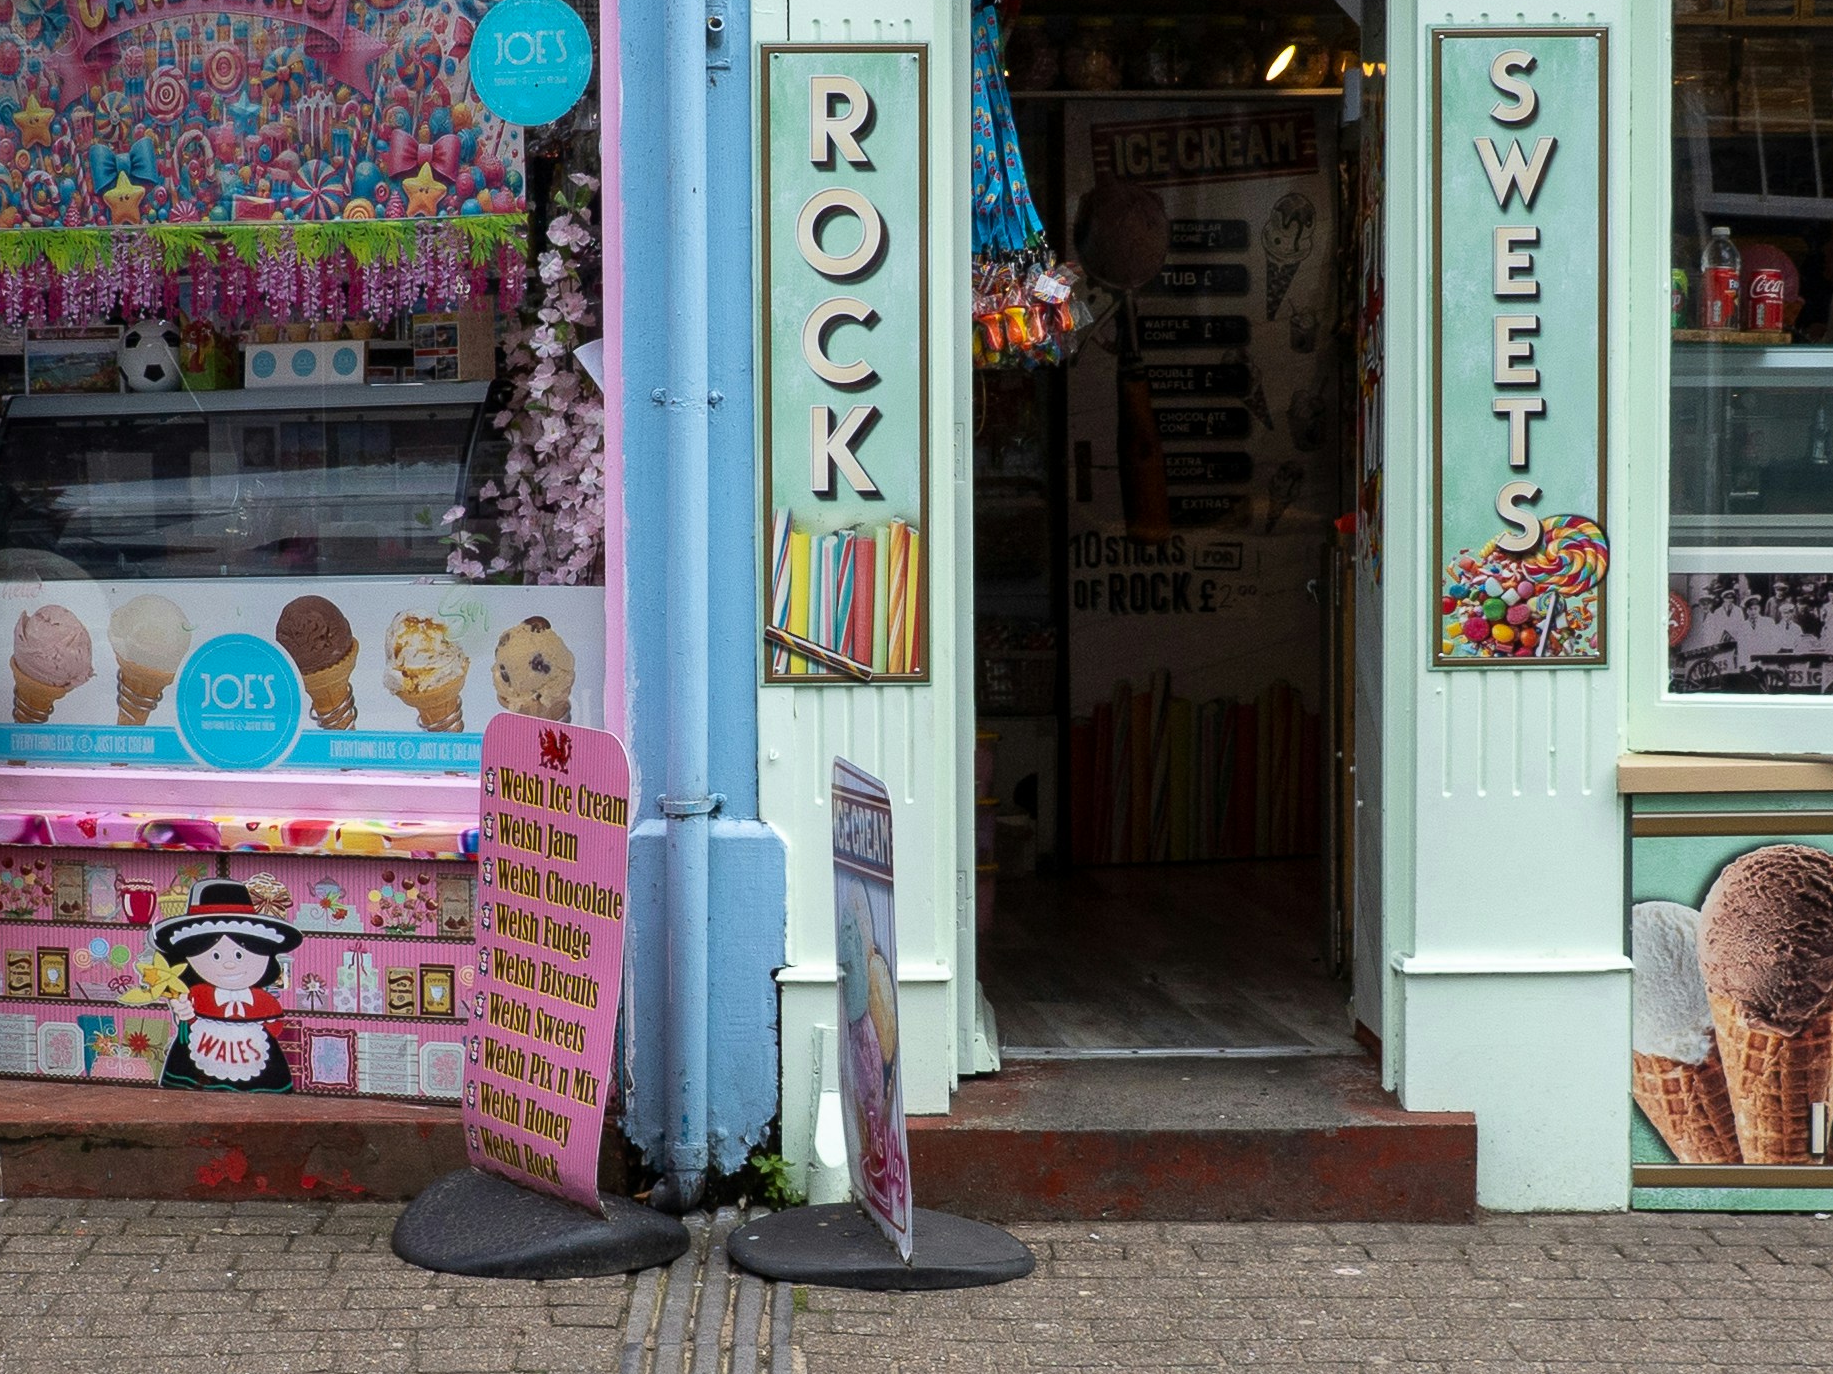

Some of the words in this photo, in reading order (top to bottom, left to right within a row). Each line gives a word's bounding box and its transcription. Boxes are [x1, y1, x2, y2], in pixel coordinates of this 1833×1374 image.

[1114, 132, 1169, 175] ICE
[1177, 121, 1297, 172] CREAM
[794, 74, 882, 498] ROCK
[1161, 273, 1196, 286] TUB
[1474, 48, 1558, 555] SWEETS
[1181, 499, 1230, 510] EXTRAS
[1069, 530, 1101, 569] 10
[1105, 534, 1185, 566] STICKS
[1074, 579, 1103, 610] OF
[1109, 572, 1191, 614] ROCK
[201, 673, 277, 710] JOE'S
[11, 732, 56, 751] EVERYTHING
[58, 734, 75, 752] ELSE
[94, 735, 114, 753] JUST
[115, 735, 126, 753] ICE
[127, 736, 155, 754] CREAM
[329, 739, 377, 757] EVERYTHING
[378, 740, 396, 758] ELSE
[417, 742, 437, 759] JUST
[438, 743, 450, 759] ICE
[499, 767, 543, 808] Welsh
[547, 777, 572, 814] Ice
[577, 785, 628, 827] Cream
[497, 812, 543, 854] Welsh
[546, 825, 579, 863] Jam
[851, 805, 892, 867] CREAM
[496, 858, 541, 900] Welsh
[544, 871, 623, 922] Chocolate
[494, 902, 540, 946] Welsh
[542, 915, 592, 961] Fudge
[493, 947, 537, 990] Welsh
[539, 962, 599, 1011] Biscuits
[195, 1033, 262, 1065] WALES
[488, 992, 530, 1035] Welsh
[534, 1007, 587, 1054] Sweets
[484, 1037, 525, 1080] Welsh
[529, 1053, 555, 1093] Pix
[558, 1066, 567, 1092] n
[571, 1067, 600, 1107] Mix
[480, 1082, 521, 1126] Welsh
[524, 1100, 571, 1148] Honey
[480, 1126, 521, 1170] Welsh
[524, 1142, 562, 1187] Rock
